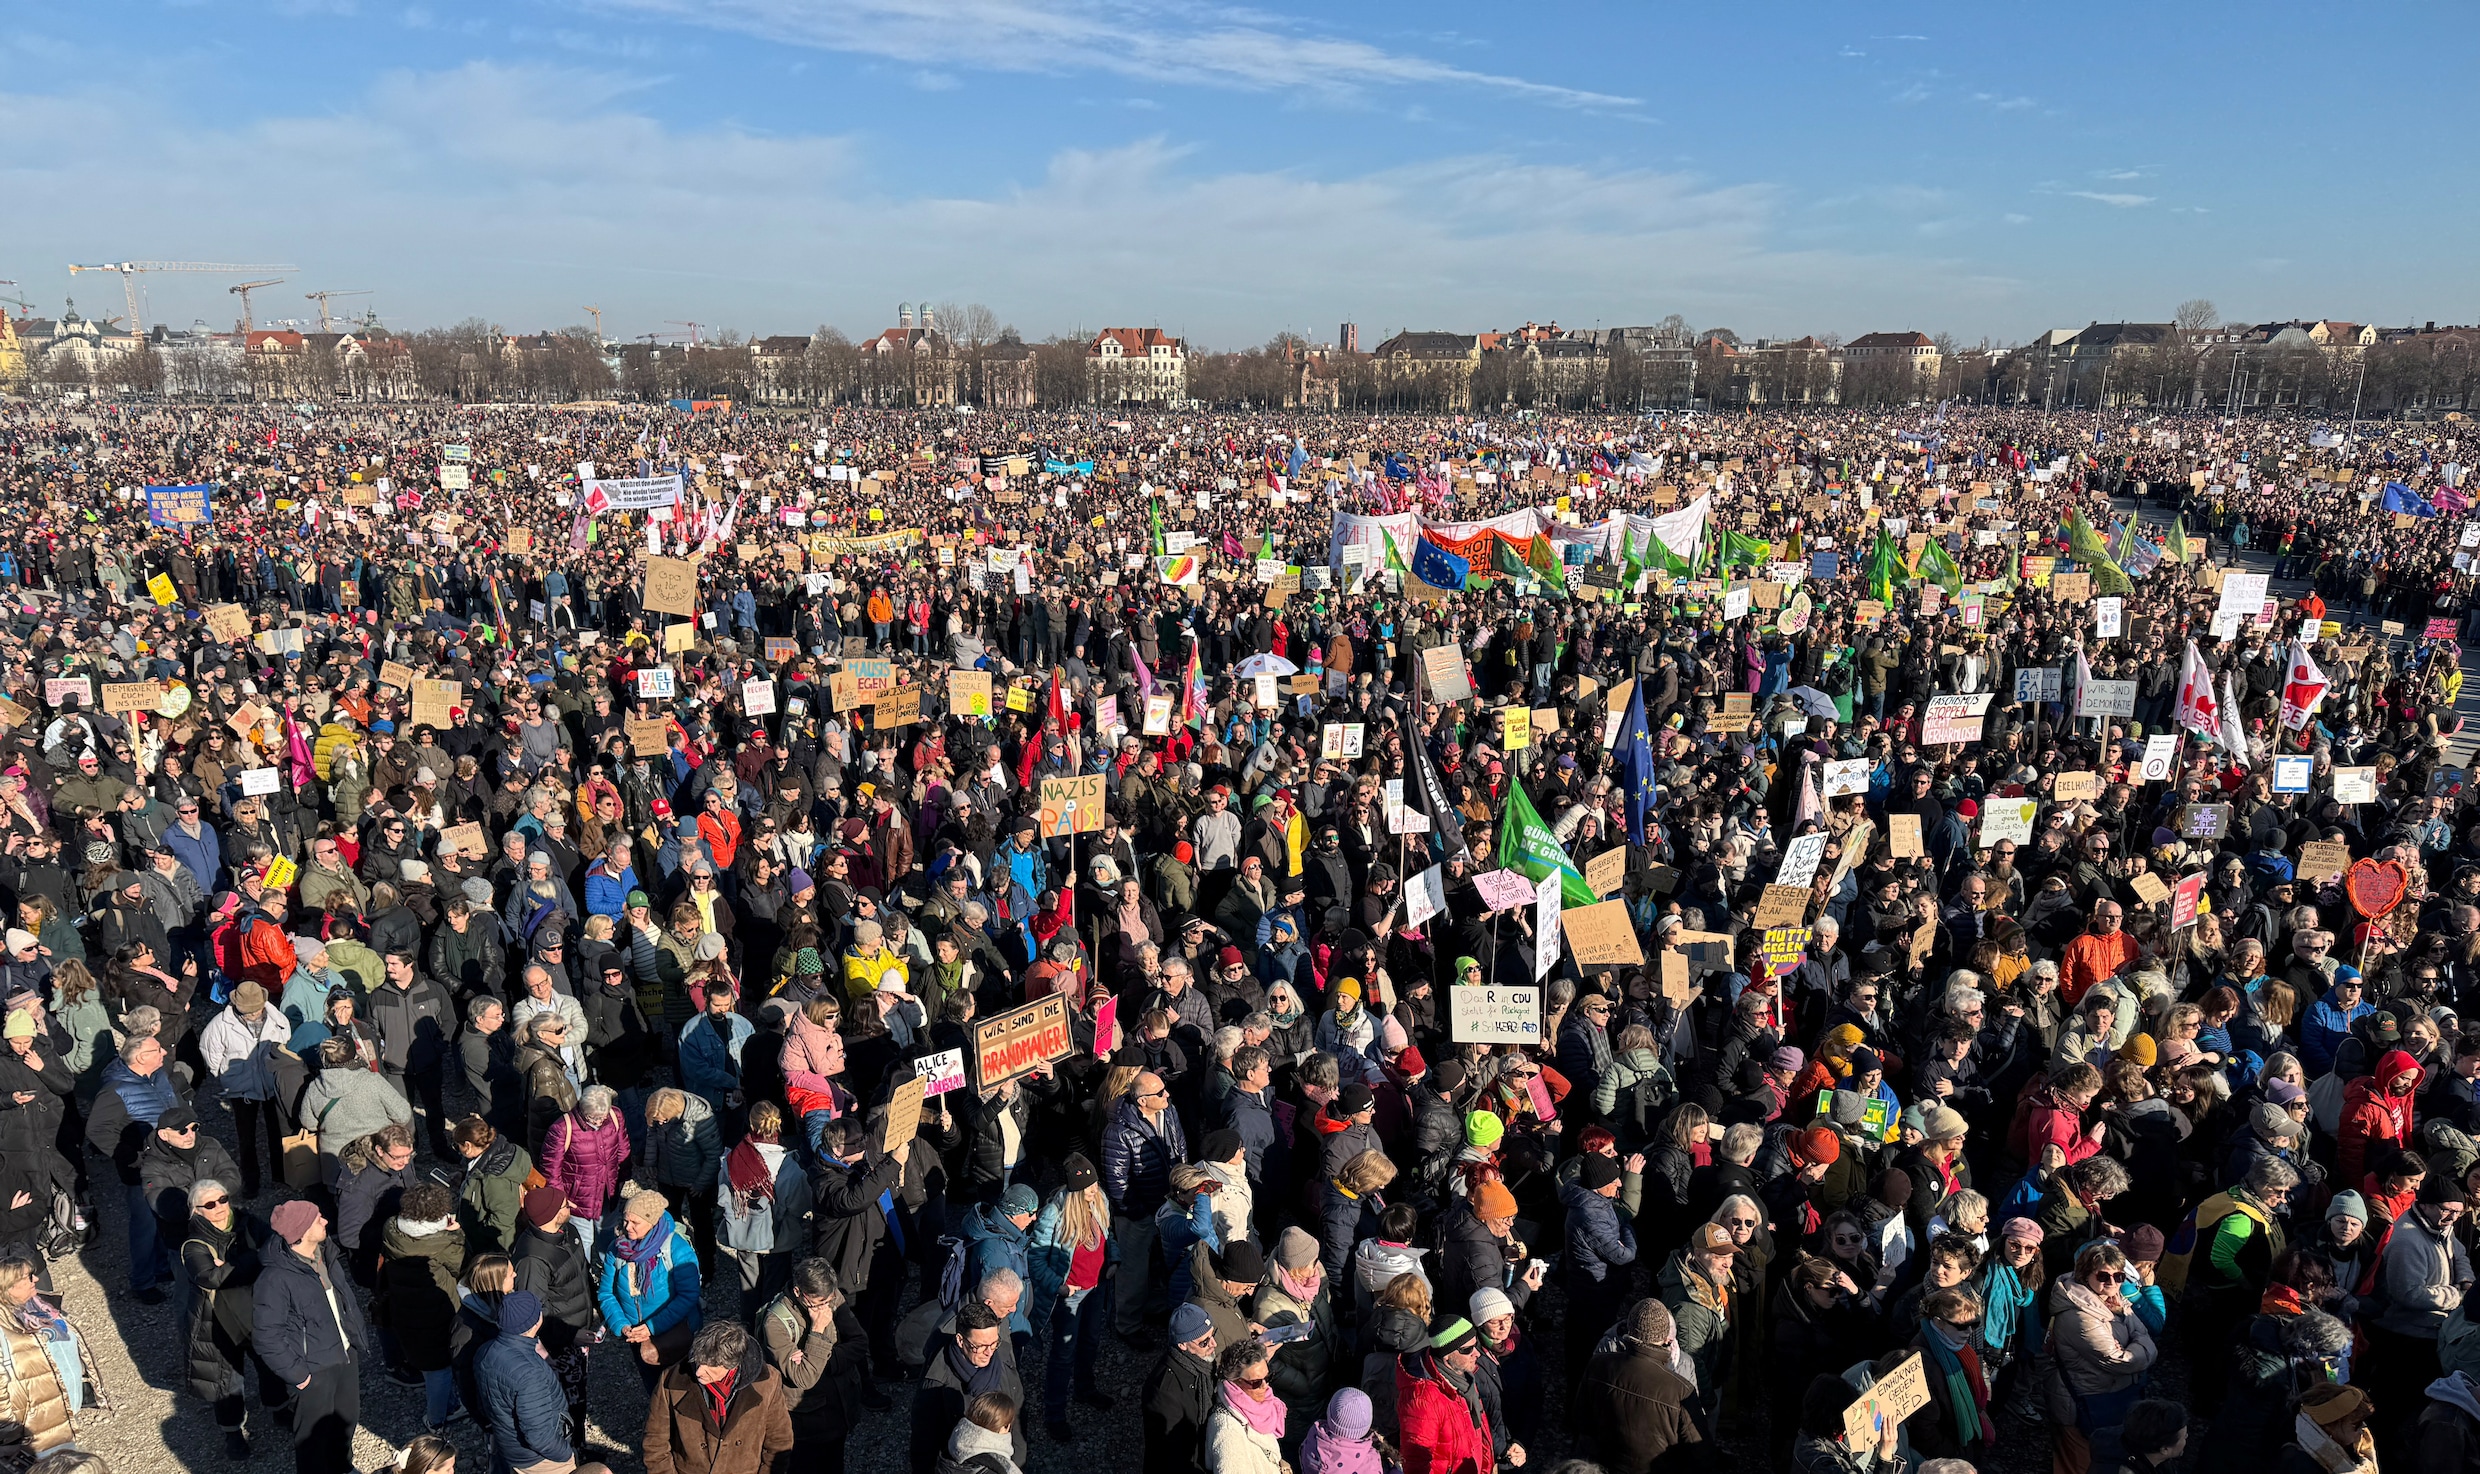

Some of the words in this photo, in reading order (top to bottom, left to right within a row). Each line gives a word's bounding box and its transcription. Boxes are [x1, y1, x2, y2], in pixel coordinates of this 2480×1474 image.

[641, 671, 671, 682] VIEL
[106, 684, 158, 693] REMIGRIERT
[641, 681, 672, 691] FALT
[2086, 685, 2108, 695] WIR
[2109, 684, 2131, 696] SIND
[121, 691, 144, 700] EUCH
[1929, 695, 1981, 707] FASCHISMUS
[2086, 699, 2133, 711] DEMOKRATIE
[1927, 705, 1969, 719] STOPPEN
[1926, 718, 1951, 731] NICHT
[1923, 725, 1982, 745] VERHARMLOSEN
[1043, 777, 1099, 802] NAZIS
[1987, 805, 2010, 816] Lieber
[1041, 803, 1102, 838] RAUS!
[2193, 814, 2218, 822] WIEDER
[2190, 827, 2218, 836] JETZT
[1484, 871, 1513, 886] RECHTS
[1764, 886, 1809, 899] GEGEN
[1758, 905, 1782, 915] PLAN
[2177, 898, 2193, 909] Karte
[1765, 928, 1812, 943] MUTTI
[1763, 942, 1805, 954] GEGEN
[1769, 952, 1800, 964] RECHTS
[1460, 991, 1485, 1004] Das
[1487, 990, 1497, 1004] R
[1512, 992, 1531, 1004] CDU
[984, 1022, 1005, 1040] WIR
[1011, 1013, 1035, 1031] SIND
[1043, 1002, 1060, 1019] DIE
[983, 1023, 1068, 1081] BRANDMAUER!
[916, 1053, 948, 1074] ALICE
[1877, 1358, 1922, 1398] EINHÖRNER
[1888, 1377, 1916, 1402] GEGEN
[1894, 1392, 1912, 1408] DIE
[1894, 1393, 1923, 1422] AFD
